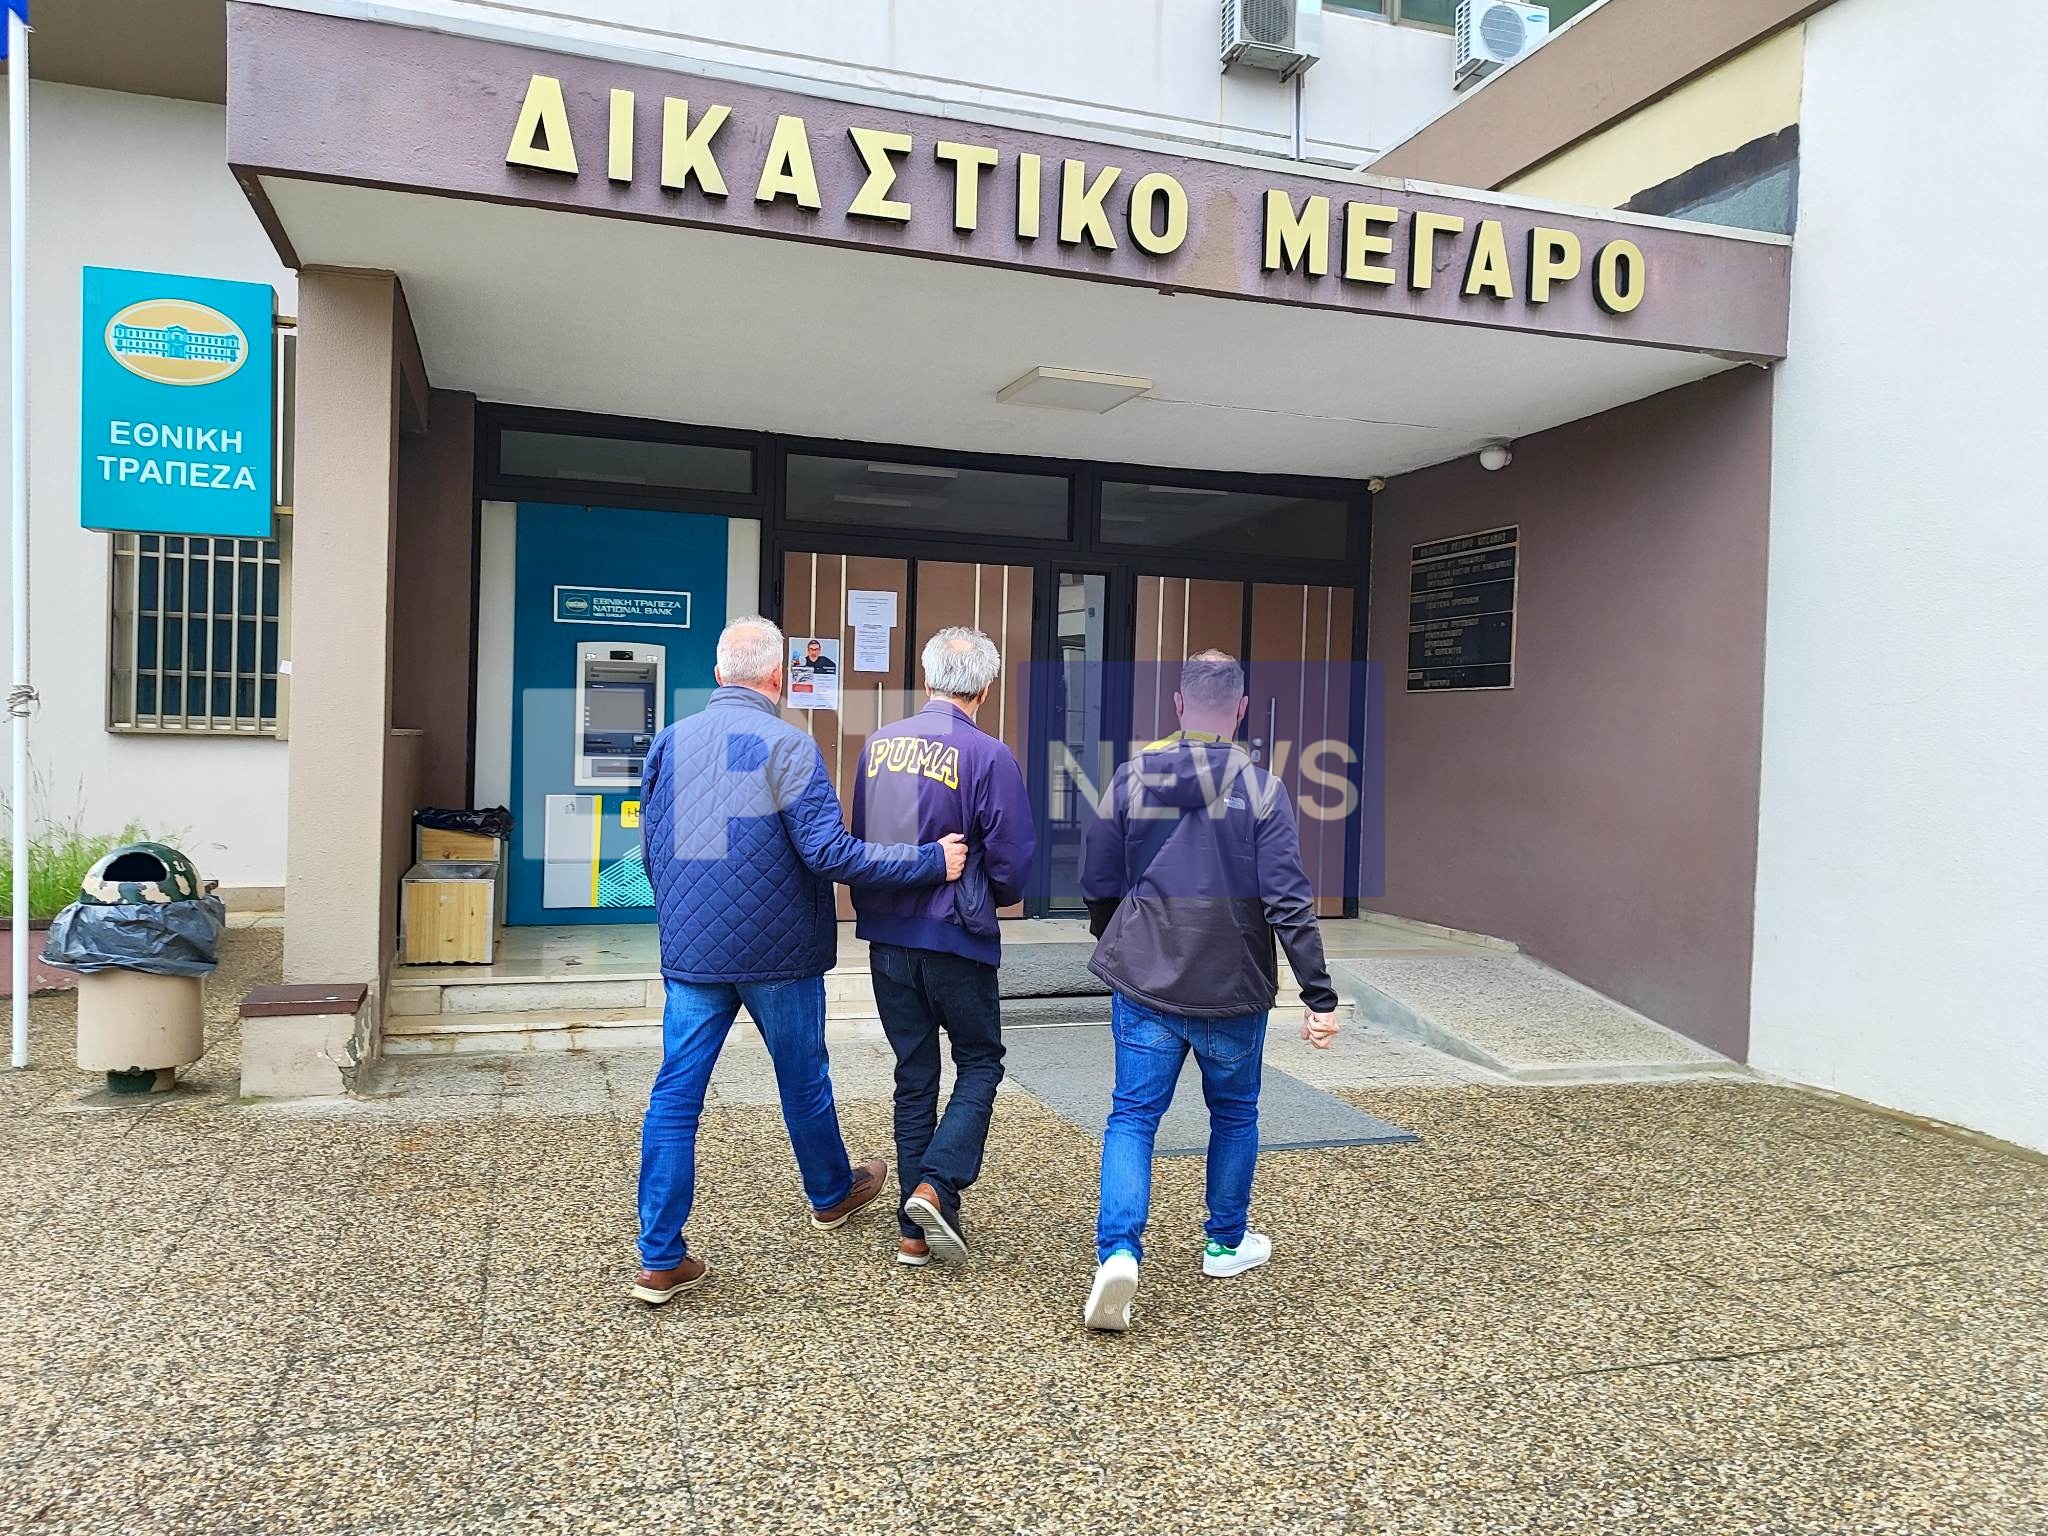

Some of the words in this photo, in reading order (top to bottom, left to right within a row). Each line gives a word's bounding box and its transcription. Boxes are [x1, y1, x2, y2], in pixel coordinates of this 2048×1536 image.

[505, 73, 1189, 256] ΔΙΚΑΣΤΙΚΟ
[1261, 189, 1646, 315] ΜΕΓΑΡΟ
[110, 420, 242, 454] ΕΘΝΙΚΗ
[97, 455, 256, 491] ΤΡΑΠΕΖΑ
[592, 605, 642, 614] NATIONAL
[644, 607, 673, 616] BANK
[633, 599, 681, 608] ΤΡΑΠΕΖΑ
[867, 736, 959, 790] PUMA
[627, 807, 640, 817] i-b
